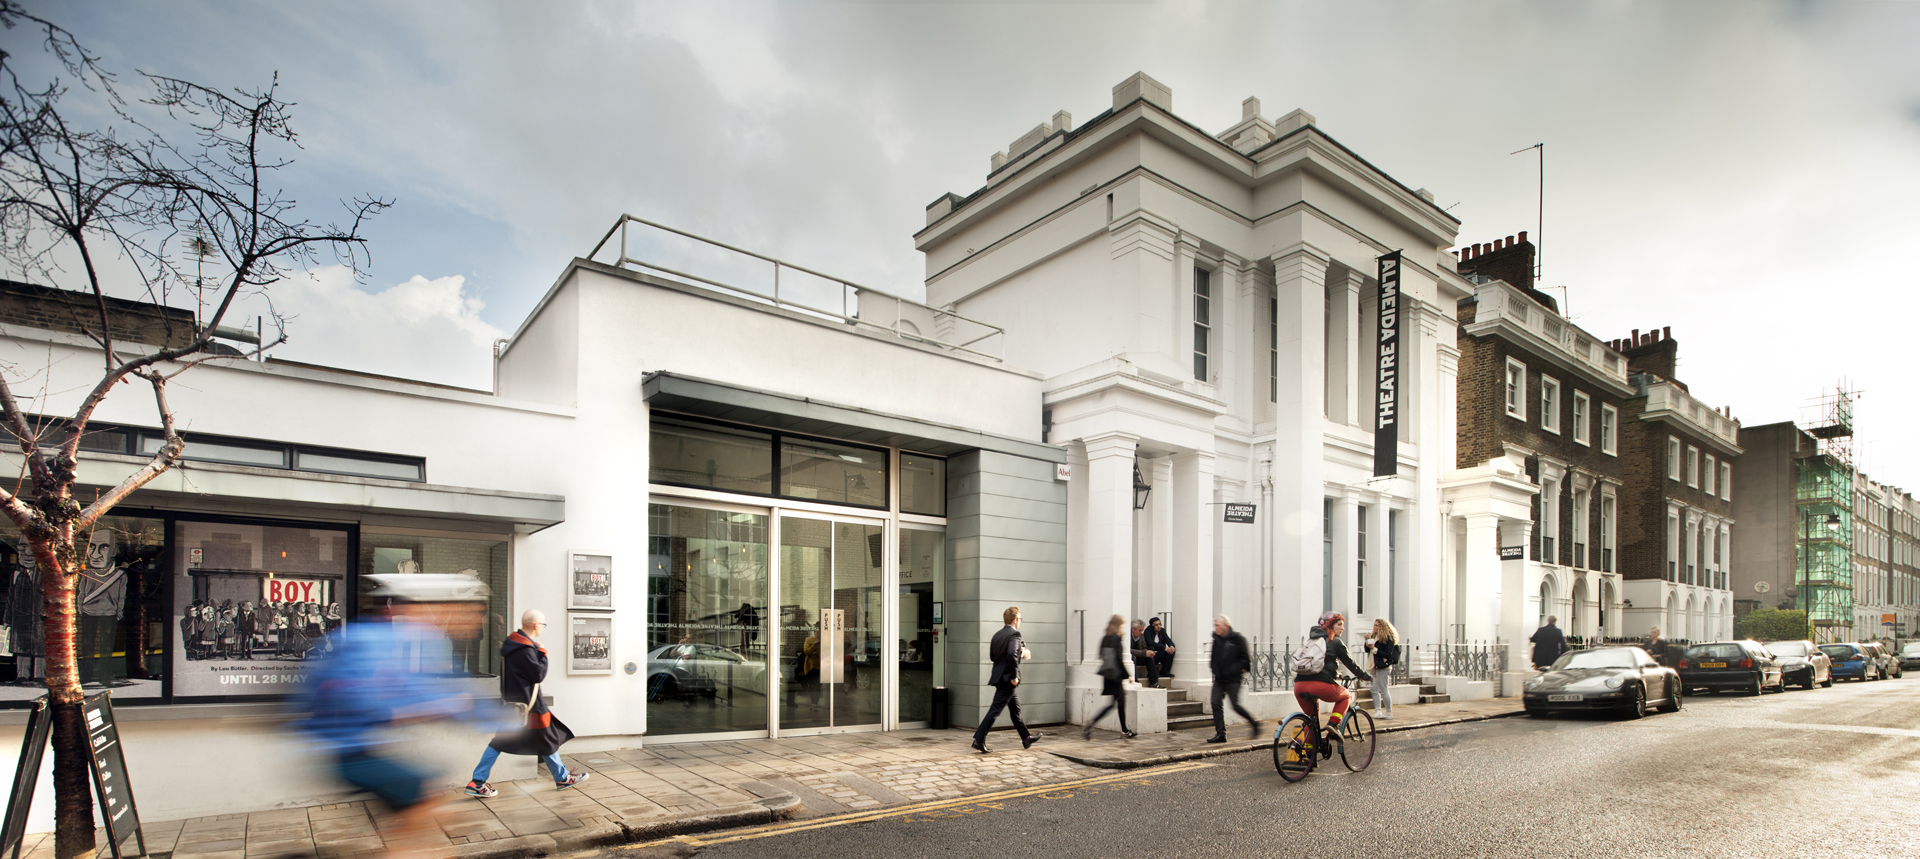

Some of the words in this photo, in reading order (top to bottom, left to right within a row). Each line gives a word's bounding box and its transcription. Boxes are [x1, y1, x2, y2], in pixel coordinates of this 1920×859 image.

[1381, 260, 1396, 342] ALMEIDA
[1379, 342, 1395, 429] THEATRE
[270, 580, 316, 602] BOY.
[220, 675, 260, 684] UNTIL
[262, 674, 277, 684] 28
[280, 674, 308, 683] MAY
